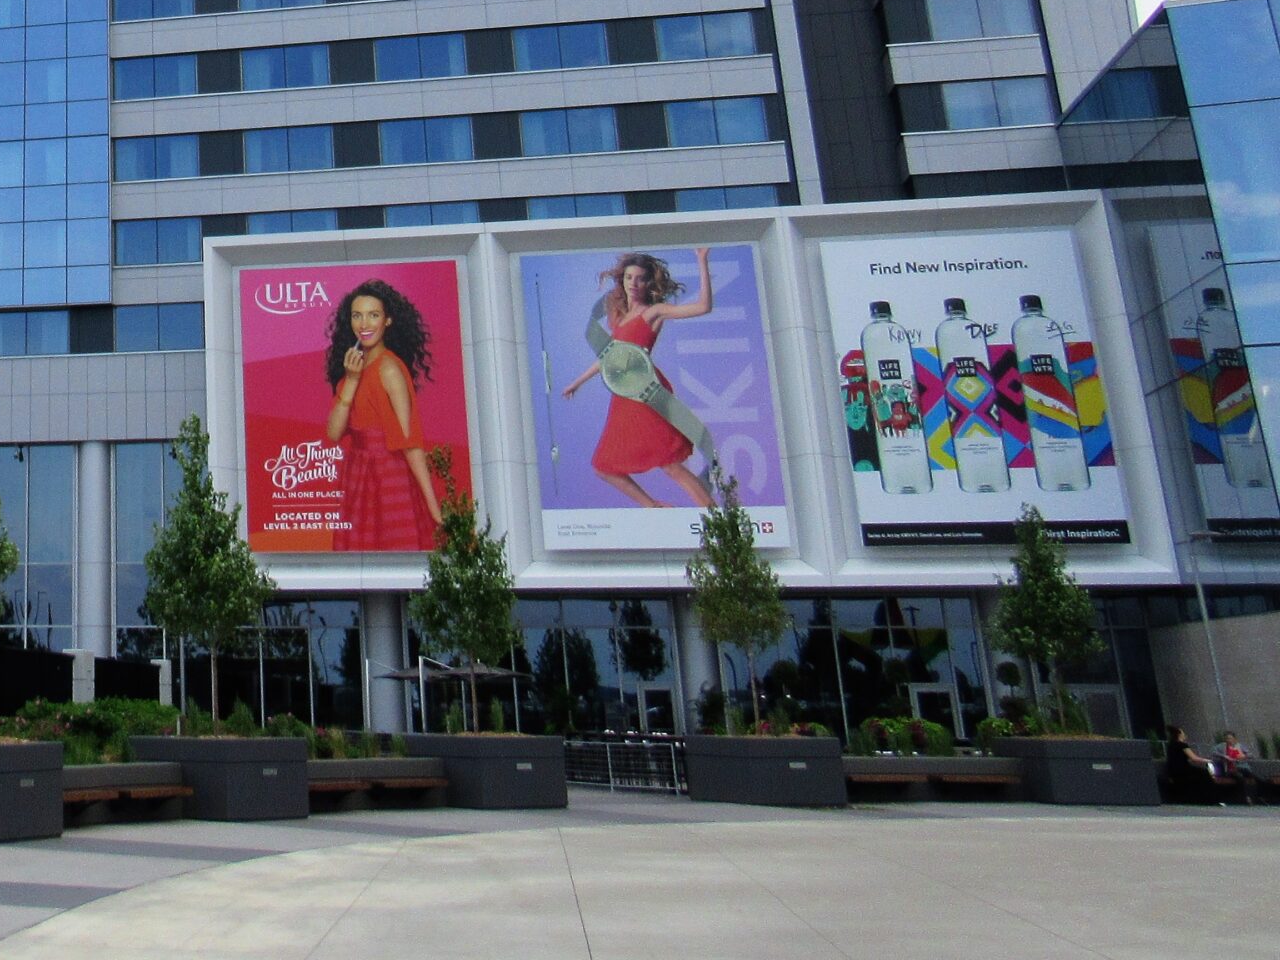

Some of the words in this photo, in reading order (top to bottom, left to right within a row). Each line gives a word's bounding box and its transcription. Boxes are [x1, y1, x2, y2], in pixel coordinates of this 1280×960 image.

[869, 262, 902, 275] Find
[905, 261, 939, 274] New
[943, 257, 1028, 274] Inspiration.
[265, 281, 329, 304] ULTA
[879, 362, 898, 370] LIFE
[264, 445, 299, 472] All
[296, 440, 344, 469] Things
[272, 491, 287, 499] ALL
[275, 512, 322, 521] LOCATED
[324, 512, 340, 520] ON
